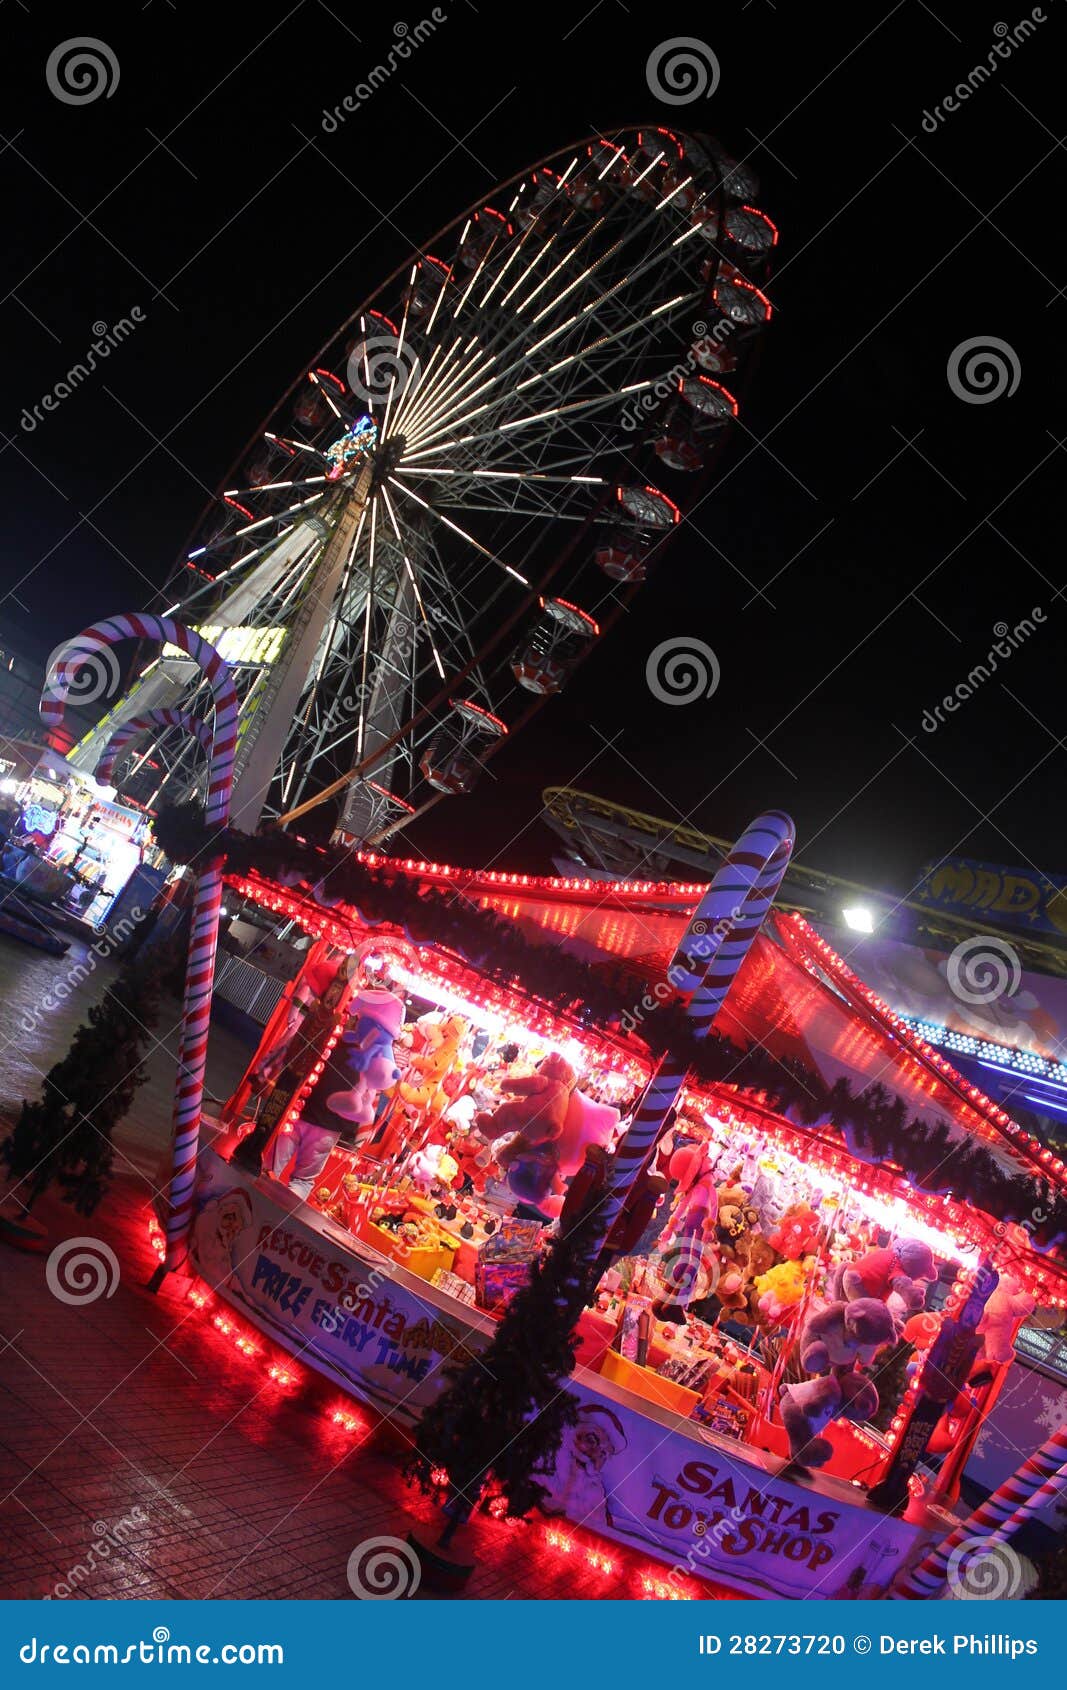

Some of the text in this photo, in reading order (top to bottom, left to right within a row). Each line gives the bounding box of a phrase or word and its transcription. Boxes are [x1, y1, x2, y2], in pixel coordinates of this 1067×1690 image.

[930, 863, 1041, 912] MAD
[252, 1254, 313, 1317] PRIZE
[311, 1299, 376, 1352] EVERY
[256, 1225, 407, 1340] RESCUE Santa
[646, 1480, 835, 1571] TOY SHOP
[675, 1461, 841, 1534] SANTAS
